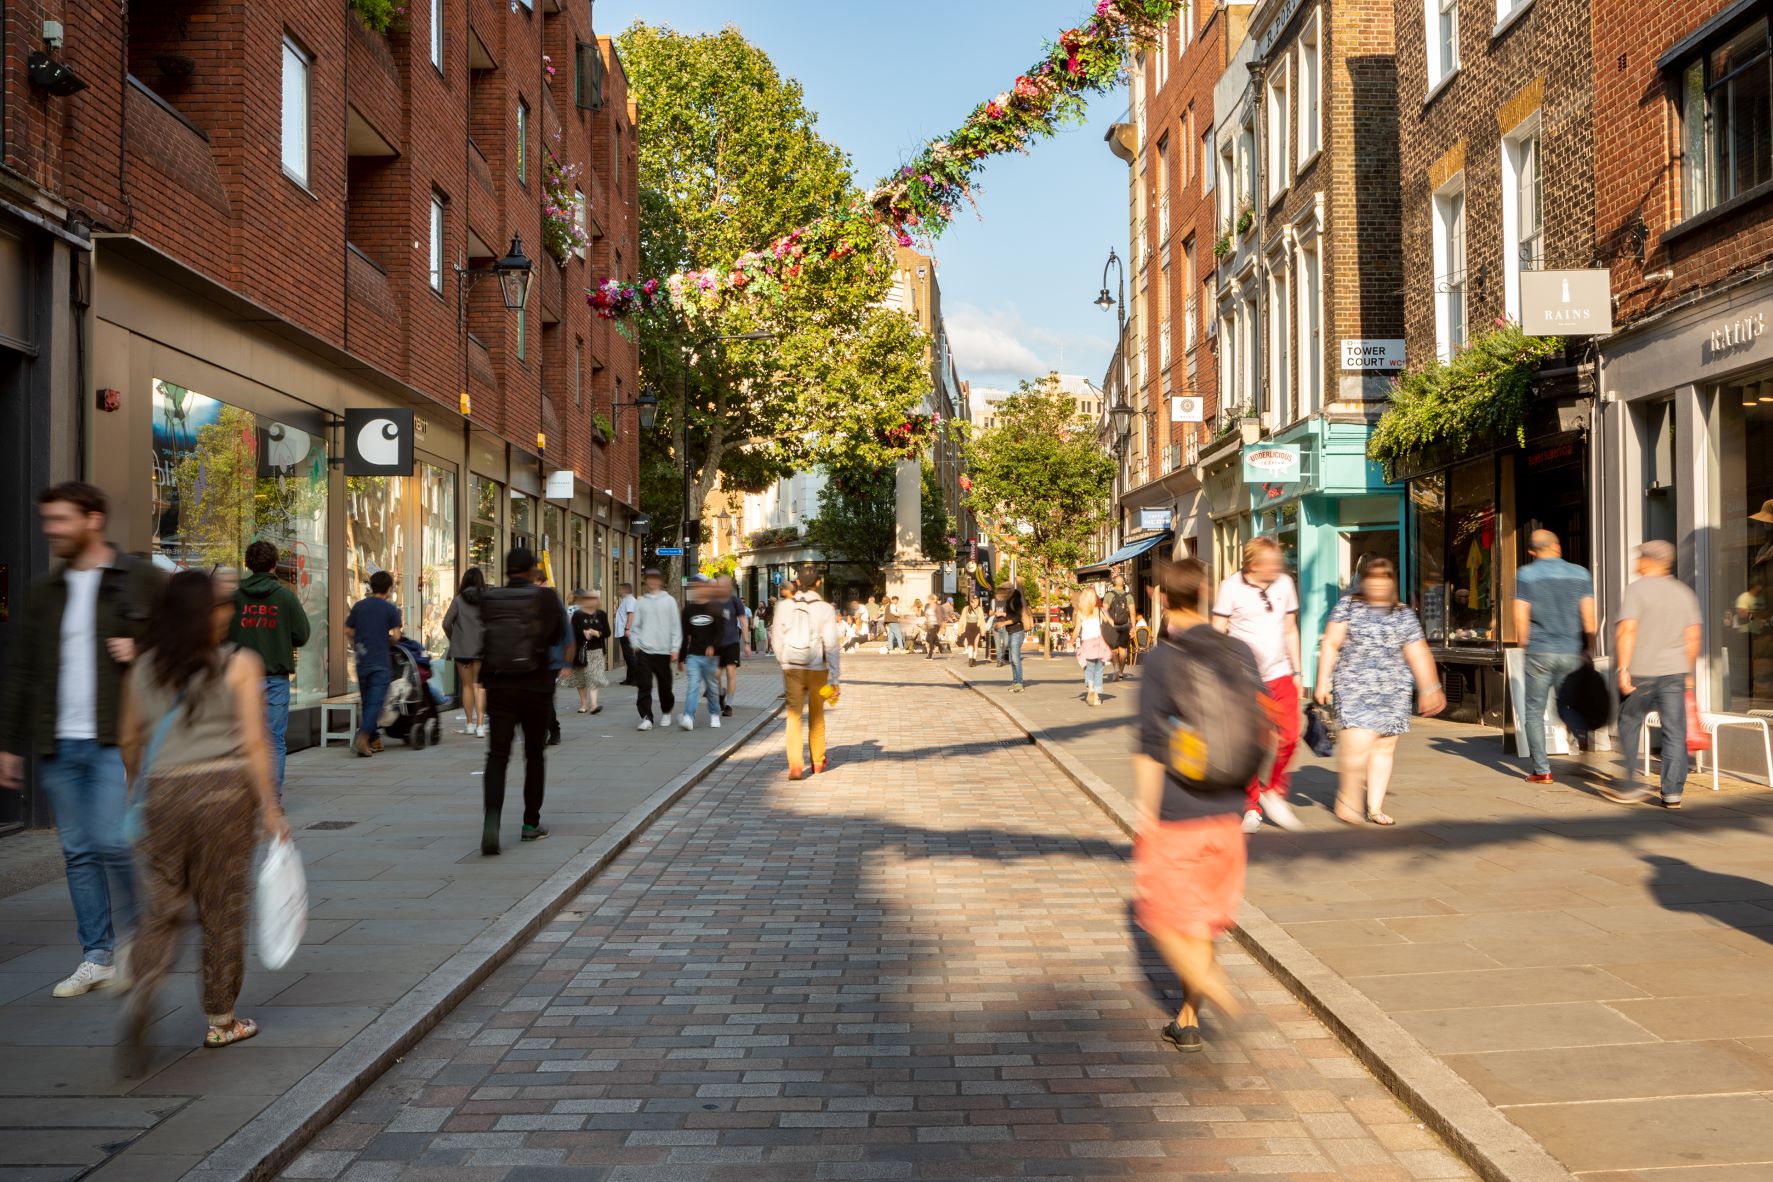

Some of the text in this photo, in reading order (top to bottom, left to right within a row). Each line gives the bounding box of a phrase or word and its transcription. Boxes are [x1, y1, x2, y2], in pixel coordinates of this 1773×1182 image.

[1544, 309, 1590, 321] RAINS
[1711, 313, 1765, 351] RAINS
[1347, 346, 1386, 355] TOWER
[1347, 357, 1385, 366] COURT
[1250, 451, 1293, 462] UDDERLICIOUS
[242, 605, 279, 616] JCBC
